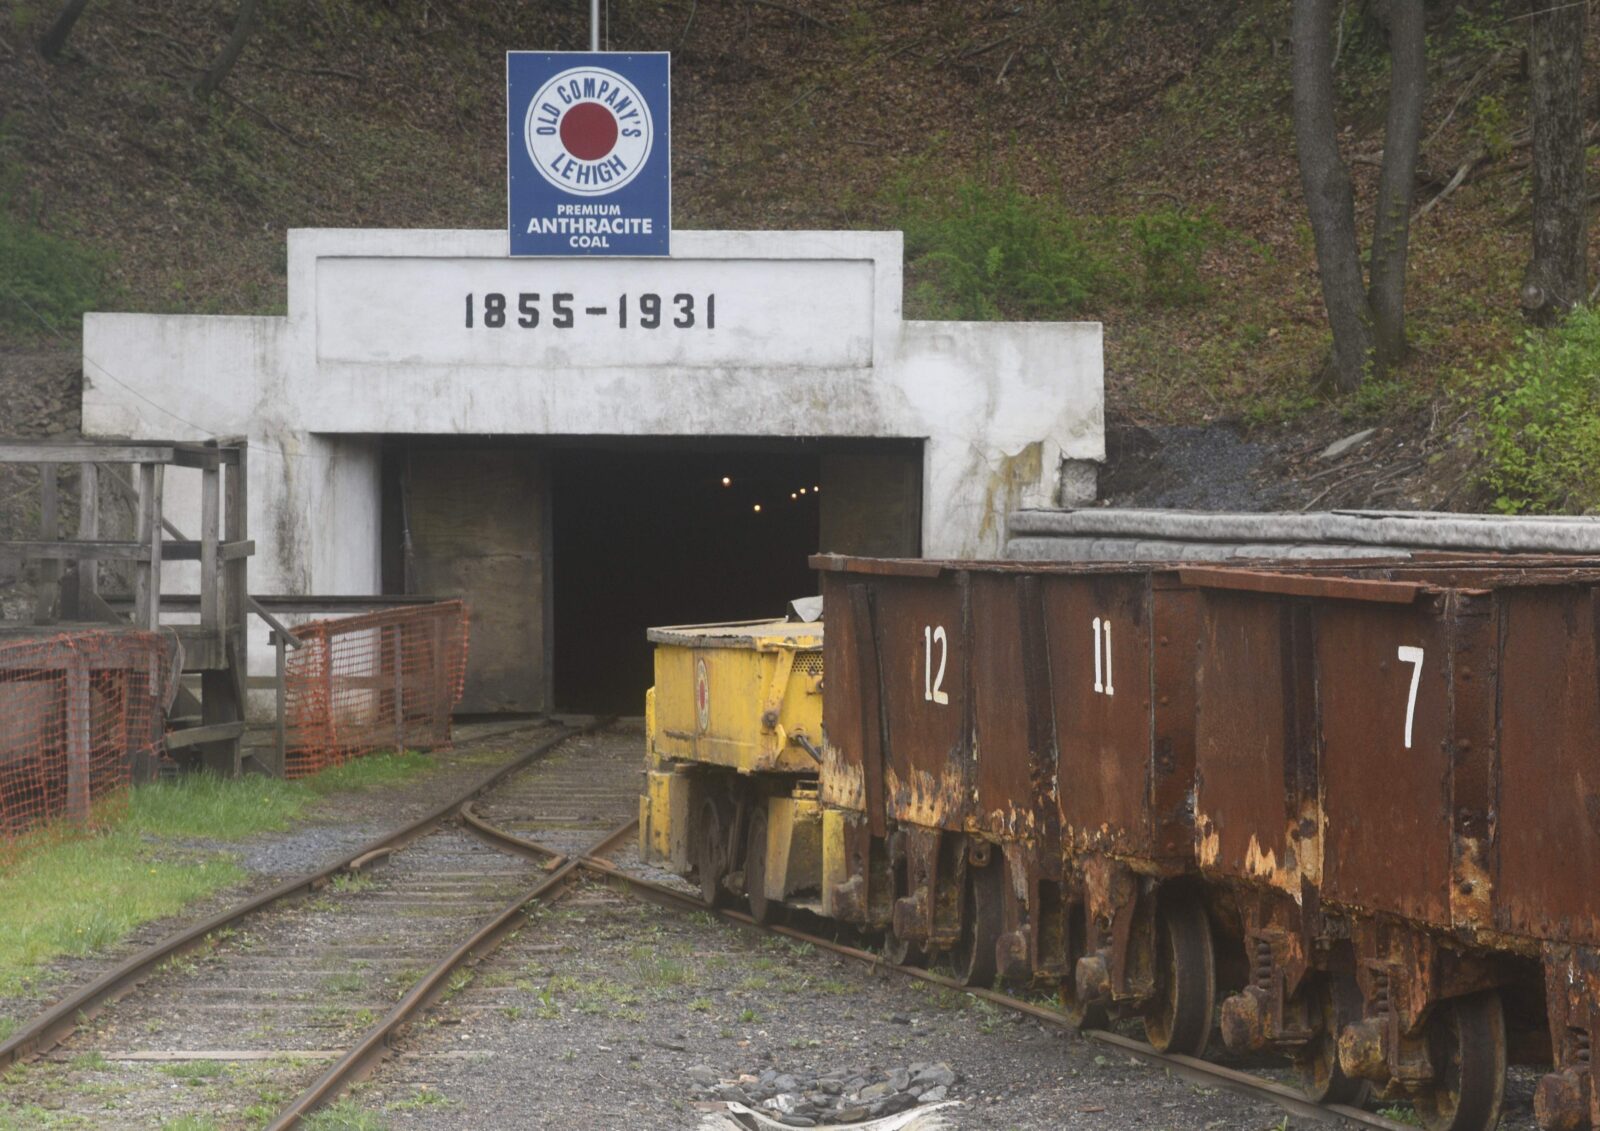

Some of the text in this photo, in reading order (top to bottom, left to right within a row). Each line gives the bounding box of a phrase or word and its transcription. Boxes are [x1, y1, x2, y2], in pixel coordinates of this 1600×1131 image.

[536, 78, 642, 138] OLD COMPANY'S
[550, 153, 627, 185] LEHIGH
[527, 218, 653, 234] ANTHRACITE
[557, 204, 620, 215] PREMIUM
[569, 236, 610, 248] COAL
[924, 625, 949, 705] 12
[1092, 616, 1114, 696] 11
[1397, 645, 1424, 749] 7
